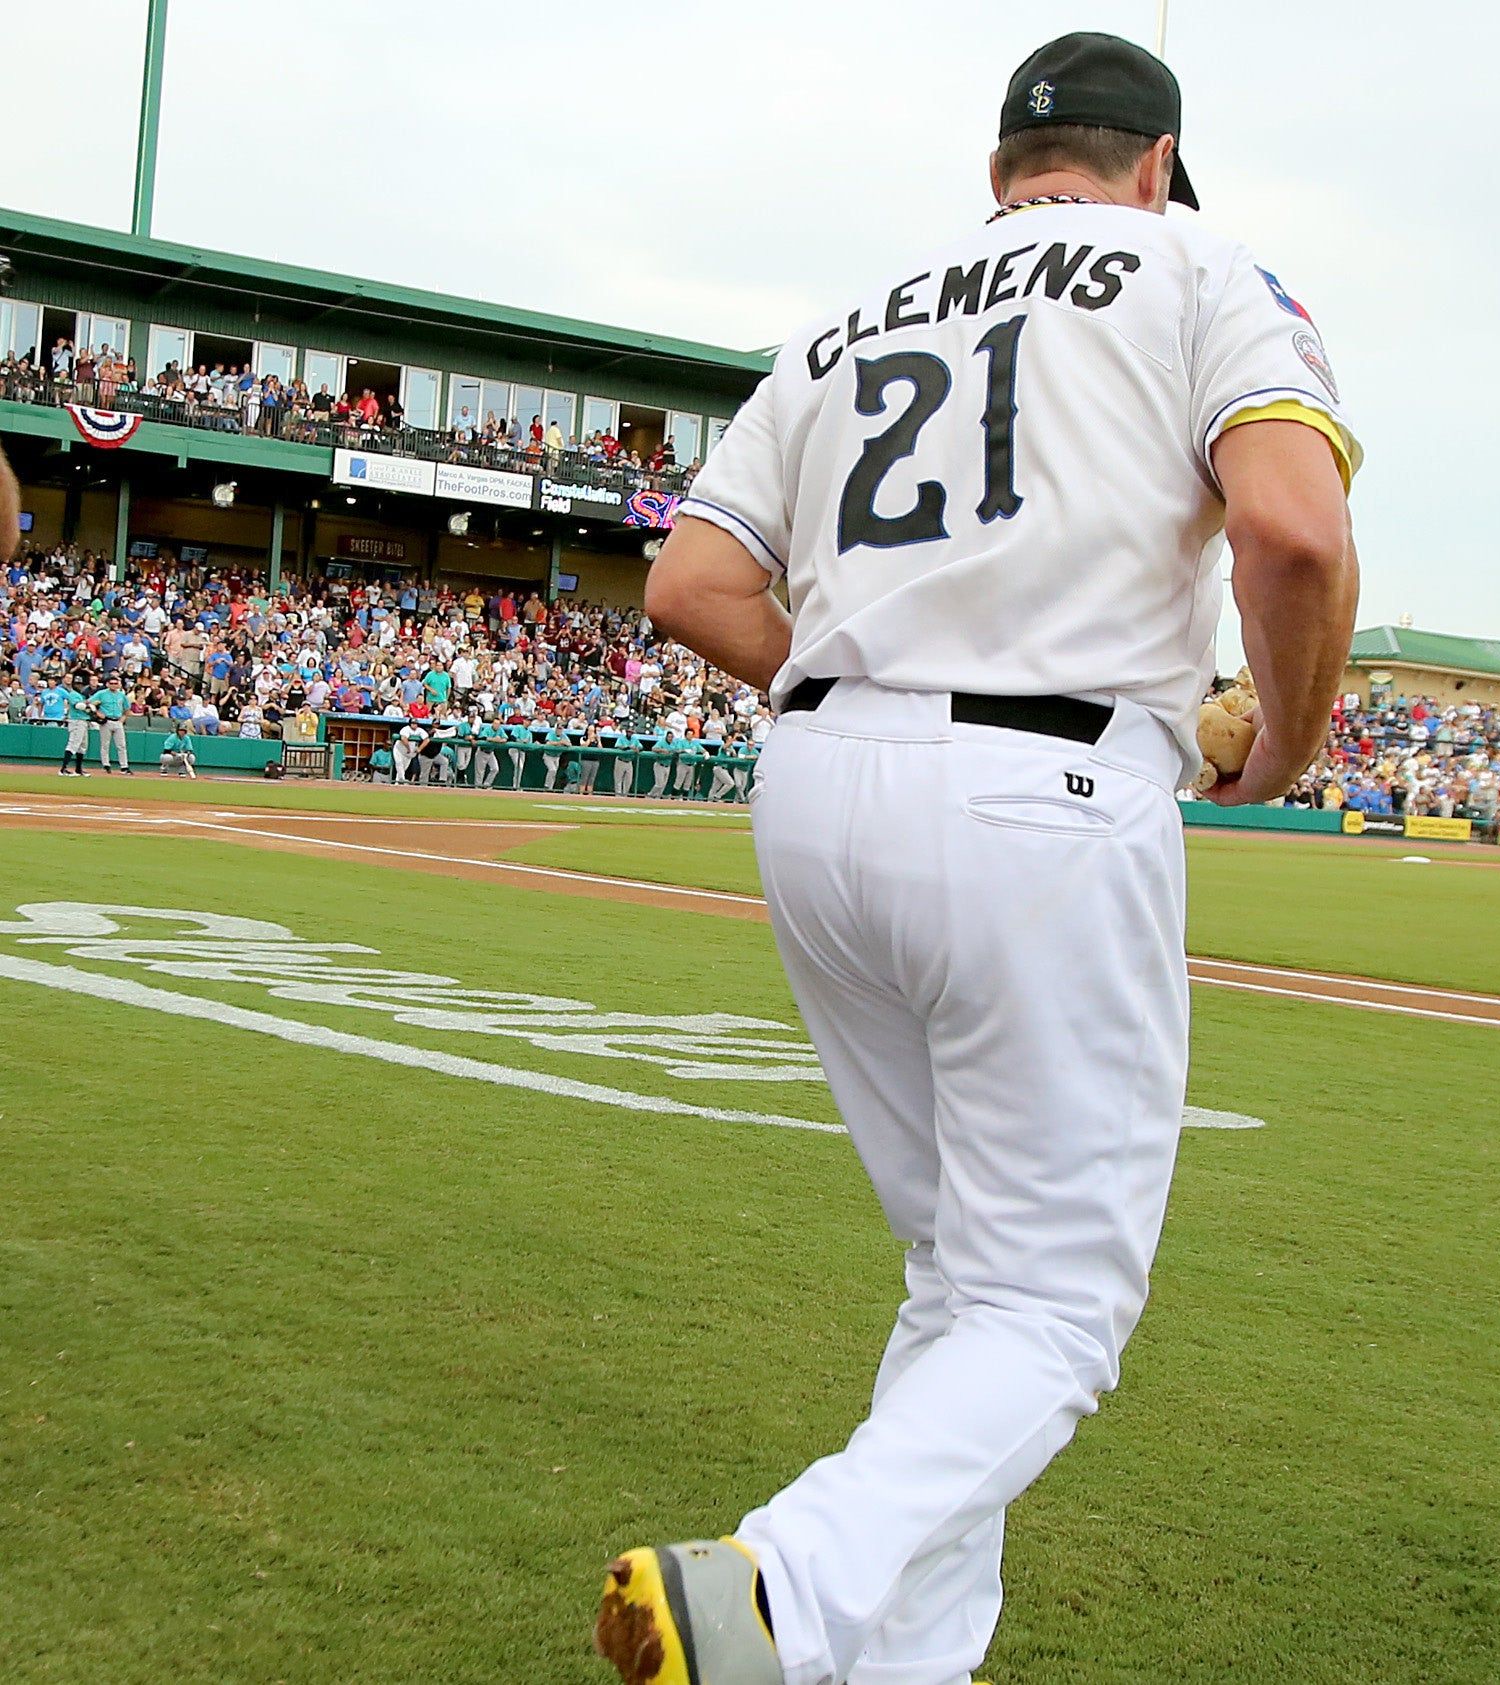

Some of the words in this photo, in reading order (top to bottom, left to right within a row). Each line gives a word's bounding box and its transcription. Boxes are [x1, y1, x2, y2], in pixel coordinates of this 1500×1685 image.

[806, 242, 1141, 381] CLEMENS
[837, 314, 1028, 555] 21
[438, 480, 532, 501] TheFootPros.com
[540, 495, 572, 514] Field
